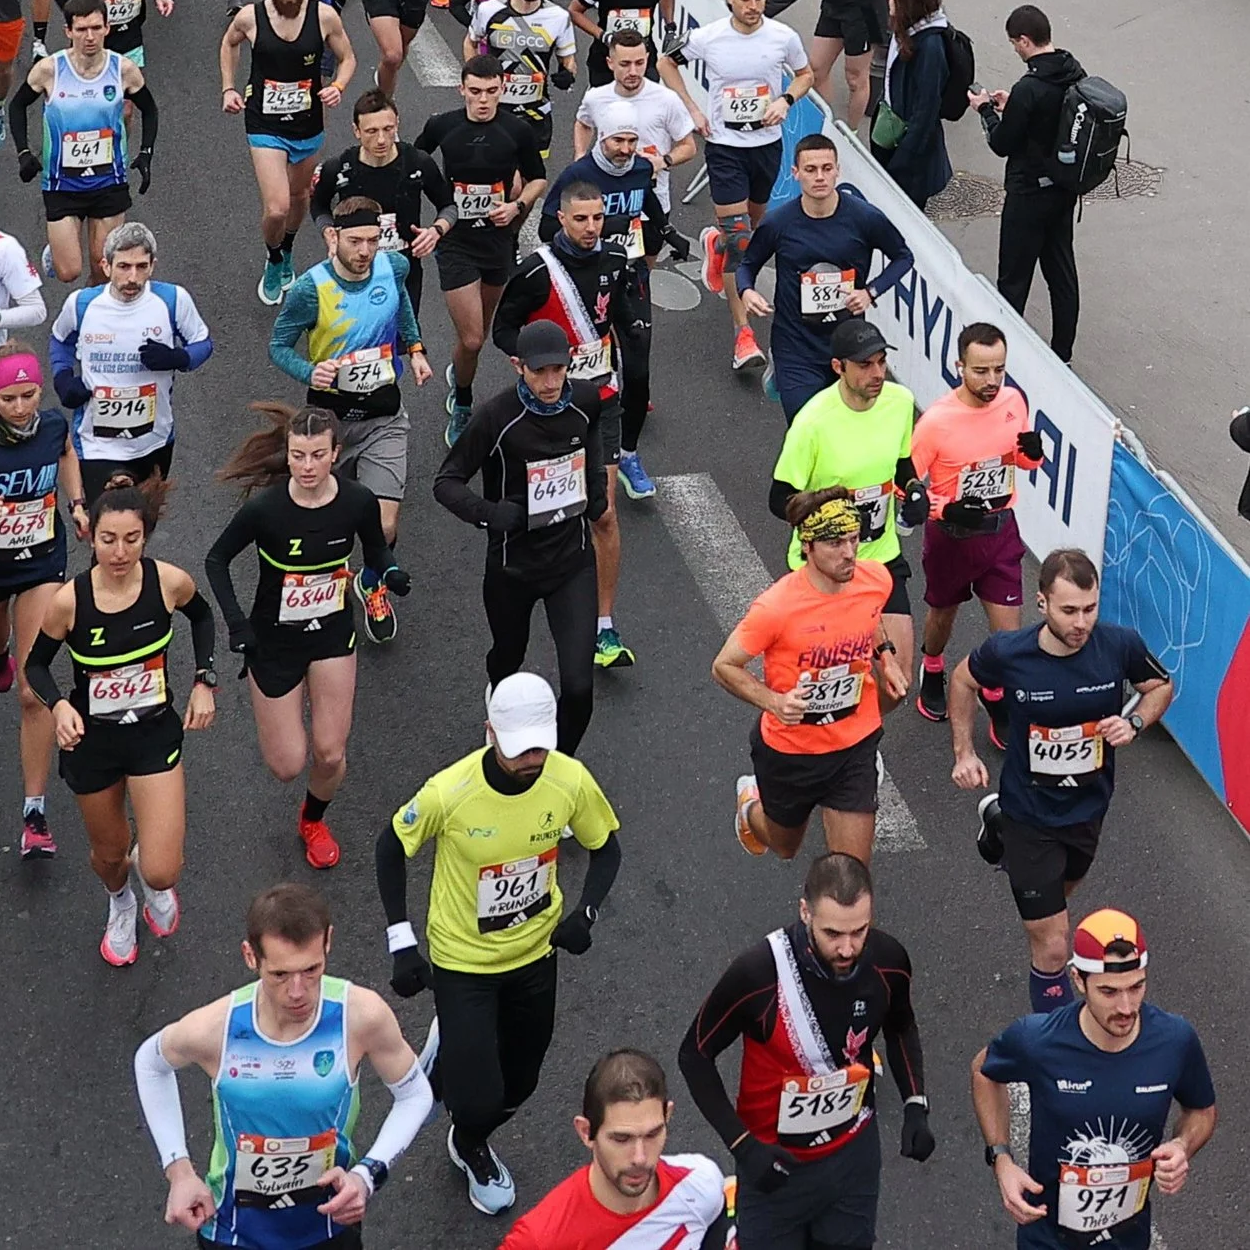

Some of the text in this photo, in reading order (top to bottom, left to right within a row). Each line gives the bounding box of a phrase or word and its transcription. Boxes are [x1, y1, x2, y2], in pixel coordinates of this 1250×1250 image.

[517, 35, 544, 47] GCC
[267, 92, 303, 105] 2455
[730, 98, 757, 112] 485
[1072, 114, 1084, 145] Colum
[72, 141, 100, 157] 641
[462, 196, 490, 209] 610
[348, 364, 380, 381] 574
[893, 266, 1077, 528] HYUAI
[98, 401, 147, 417] 3914
[534, 477, 576, 501] 6436
[963, 469, 1006, 490] 5281
[7, 534, 39, 547] AMEL
[289, 539, 302, 555] Z
[286, 584, 337, 608] 6840
[91, 628, 105, 646] Z
[93, 674, 155, 698] 6842
[802, 677, 853, 700] 3813
[1034, 740, 1092, 761] 4055
[494, 872, 538, 901] 961
[787, 1085, 855, 1119] 5185
[251, 1154, 314, 1180] 635
[254, 1177, 304, 1195] Sylvain
[1076, 1186, 1129, 1214] 971
